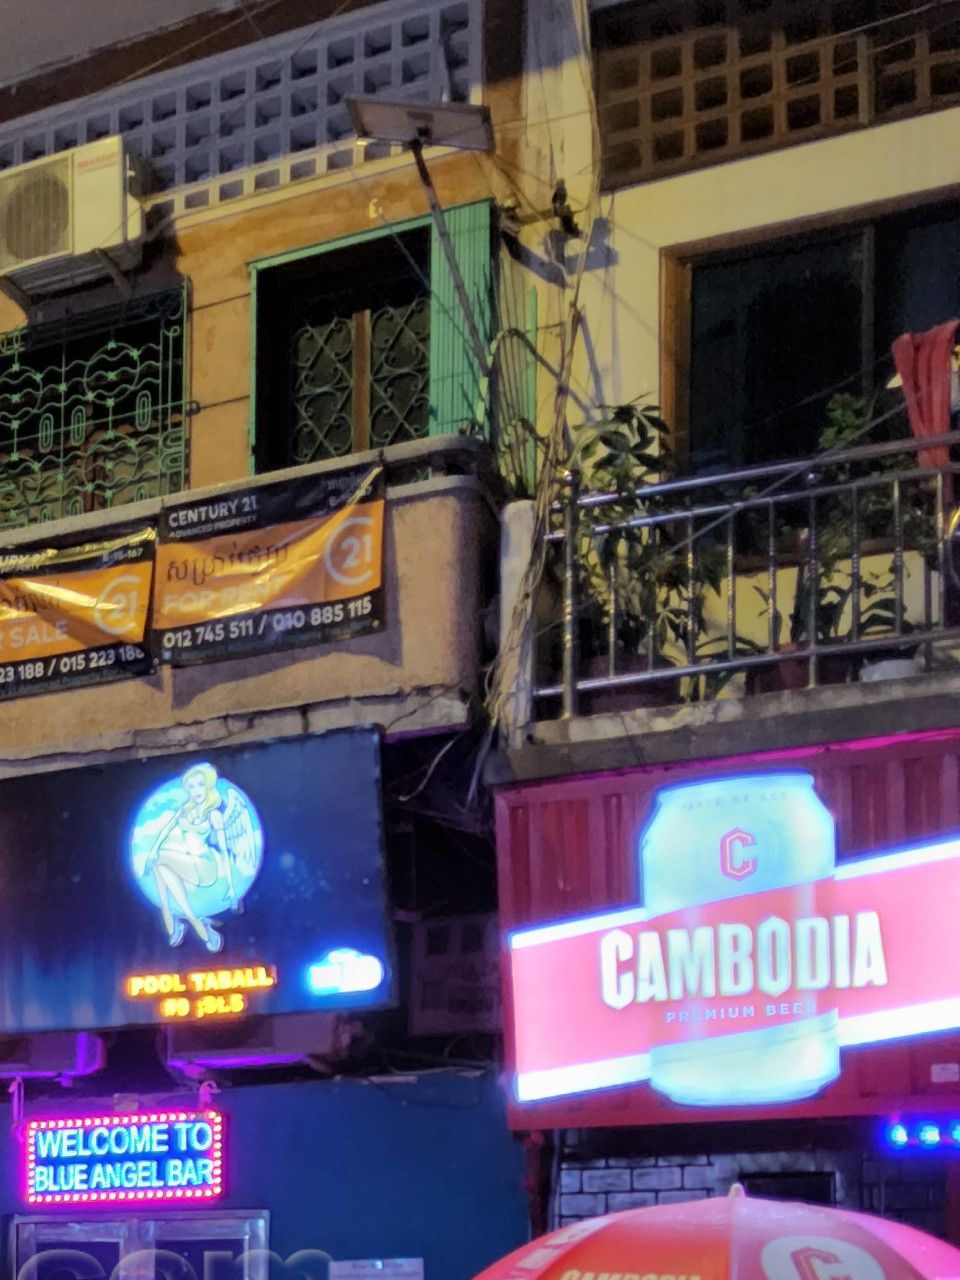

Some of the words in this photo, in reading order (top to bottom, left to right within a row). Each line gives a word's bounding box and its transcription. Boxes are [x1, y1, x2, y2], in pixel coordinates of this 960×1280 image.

[169, 499, 238, 528] CENTURY
[242, 495, 257, 512] 21
[341, 534, 372, 568] 21
[161, 589, 213, 616] FOR
[9, 620, 69, 648] SALE
[163, 631, 191, 649] 012
[197, 626, 224, 644] 745
[230, 619, 253, 638] 511
[258, 615, 268, 635] /
[273, 612, 305, 632] 010
[311, 604, 343, 626] 885
[348, 596, 372, 619] 115
[18, 661, 44, 680] 188
[47, 659, 55, 677] /
[60, 654, 86, 674] 015
[90, 648, 115, 668] 223
[600, 911, 888, 1010] CAMBODIA
[130, 973, 187, 997] POOL
[665, 1005, 755, 1023] PREMIUM
[766, 1002, 817, 1016] BEER
[37, 1123, 169, 1158] WELCOME
[174, 1121, 213, 1151] TO
[35, 1163, 88, 1192] BLUE
[91, 1160, 165, 1189] ANGEL
[167, 1158, 215, 1186] BAR
